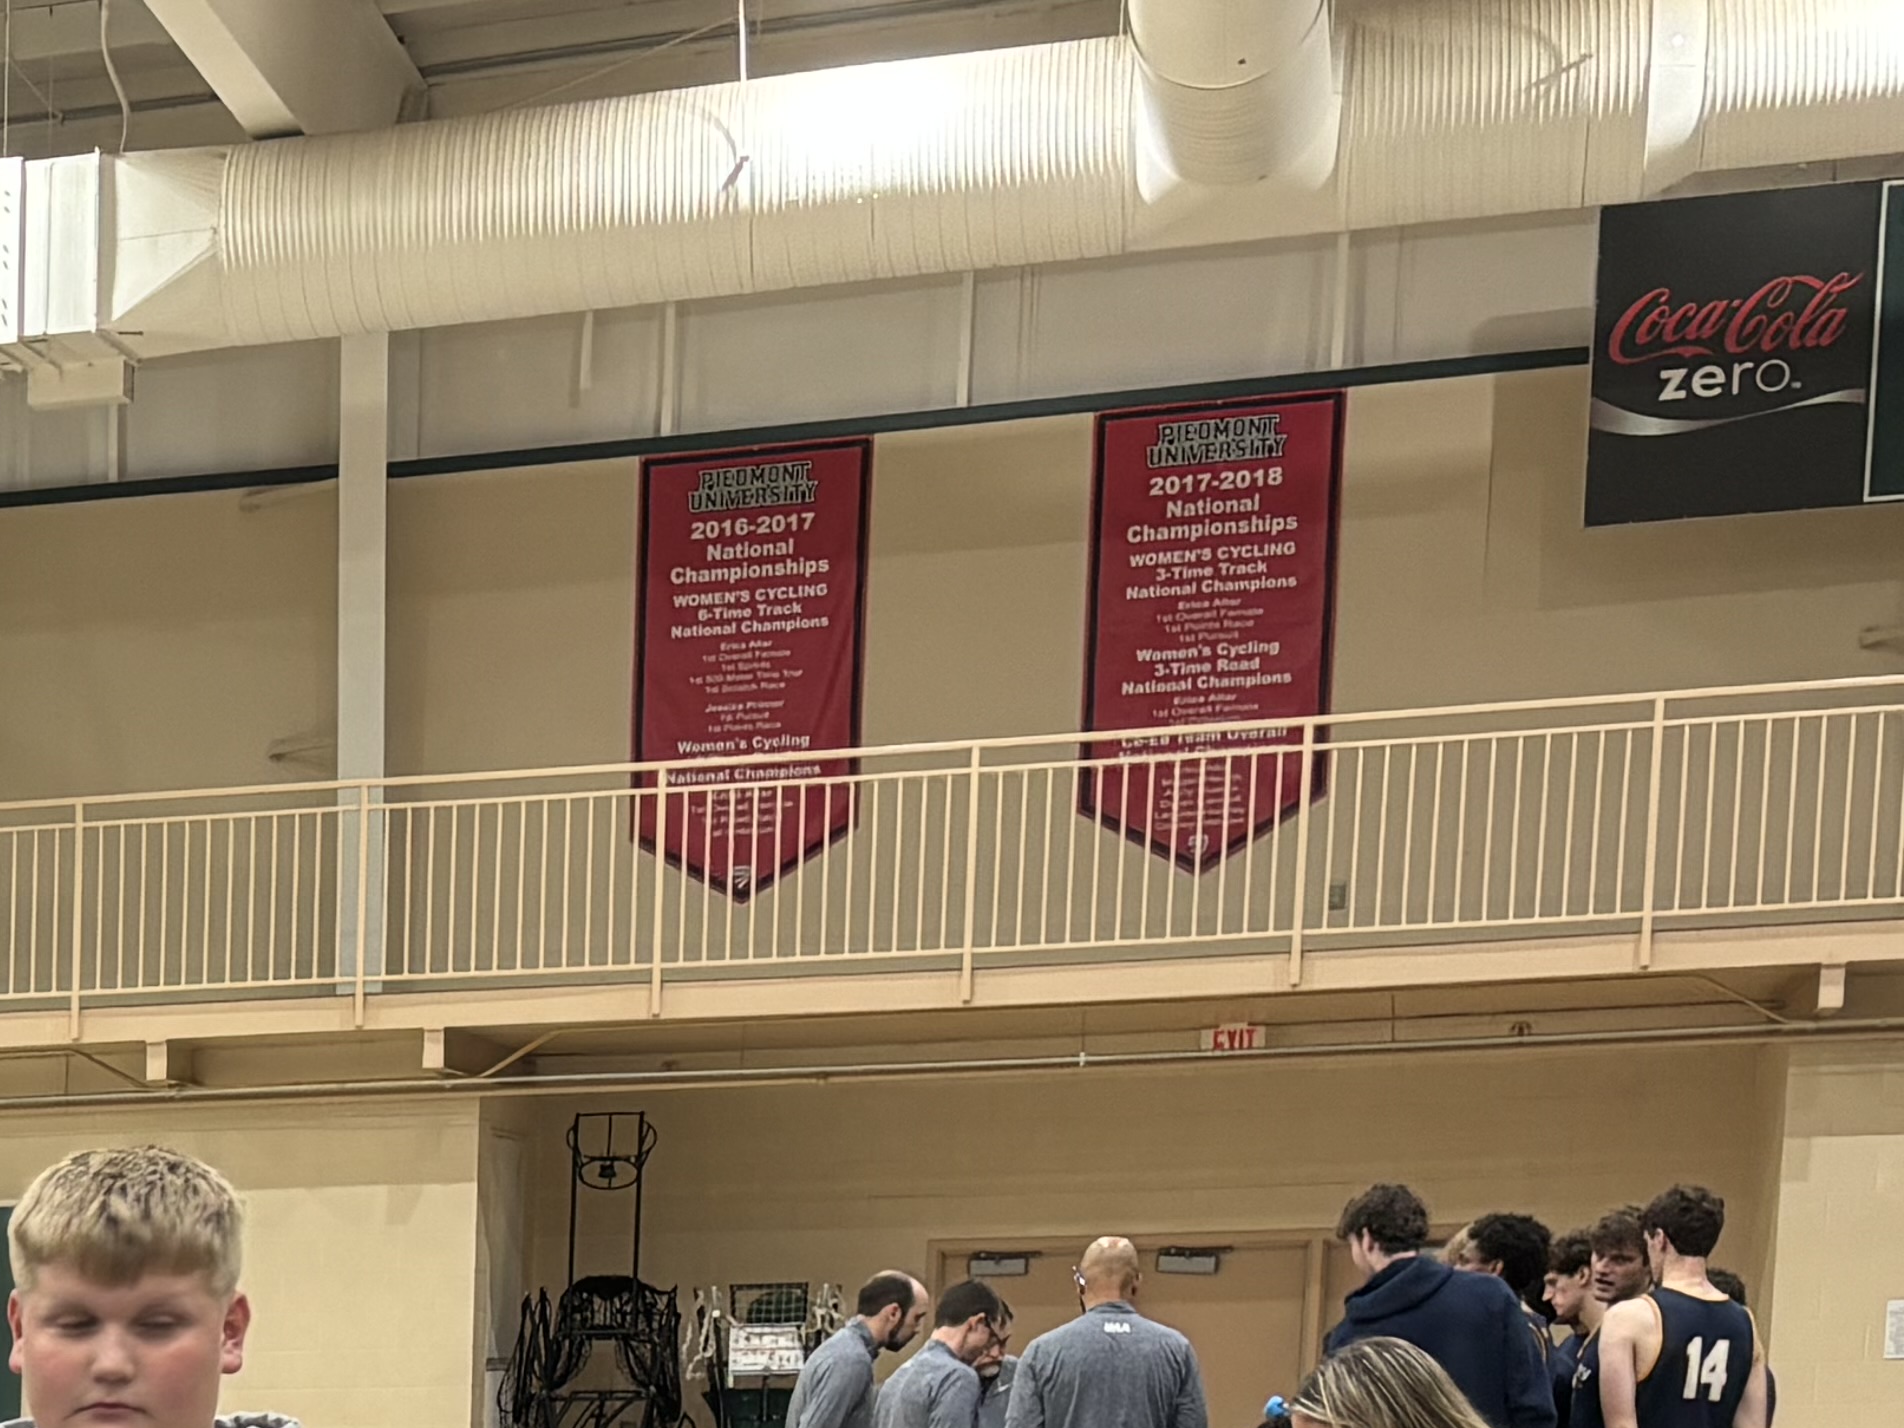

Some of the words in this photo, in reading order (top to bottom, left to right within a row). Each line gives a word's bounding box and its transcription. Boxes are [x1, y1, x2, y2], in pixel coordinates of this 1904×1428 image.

[1607, 271, 1865, 366] Coca-Cola
[1158, 414, 1280, 445] PIEDMONT
[1147, 434, 1288, 468] UNIVERSITY
[699, 461, 812, 490] PIEDMONT
[1149, 467, 1283, 496] 2017-2018
[688, 480, 818, 513] UNIVERSITY
[1166, 493, 1260, 518] National
[690, 512, 816, 540] 2016-2017
[1127, 514, 1298, 543] Championships
[707, 538, 794, 561] National
[1130, 548, 1212, 567] WOMEN'S
[1217, 542, 1296, 560] CYCLING
[670, 557, 830, 585] Championships
[1156, 566, 1213, 581] 3-Time
[1218, 560, 1267, 576] Track
[673, 590, 750, 608] WOMEN'S
[755, 583, 828, 601] CYCLING
[1126, 582, 1197, 599] National
[1201, 575, 1297, 593] Champions
[697, 606, 752, 622] 6-Time
[757, 601, 802, 616] Track
[671, 622, 736, 639] National
[741, 616, 829, 634] Champions
[1136, 645, 1212, 662] Women's
[1216, 641, 1280, 658] Cycling
[1154, 662, 1212, 677] 3-Time
[1217, 657, 1260, 673] Road
[1121, 678, 1192, 696] National
[1197, 672, 1292, 689] Champions
[677, 738, 747, 755] Women's
[751, 735, 811, 750] Cycling
[734, 764, 821, 780] Champions
[1683, 1336, 1730, 1402] 14
